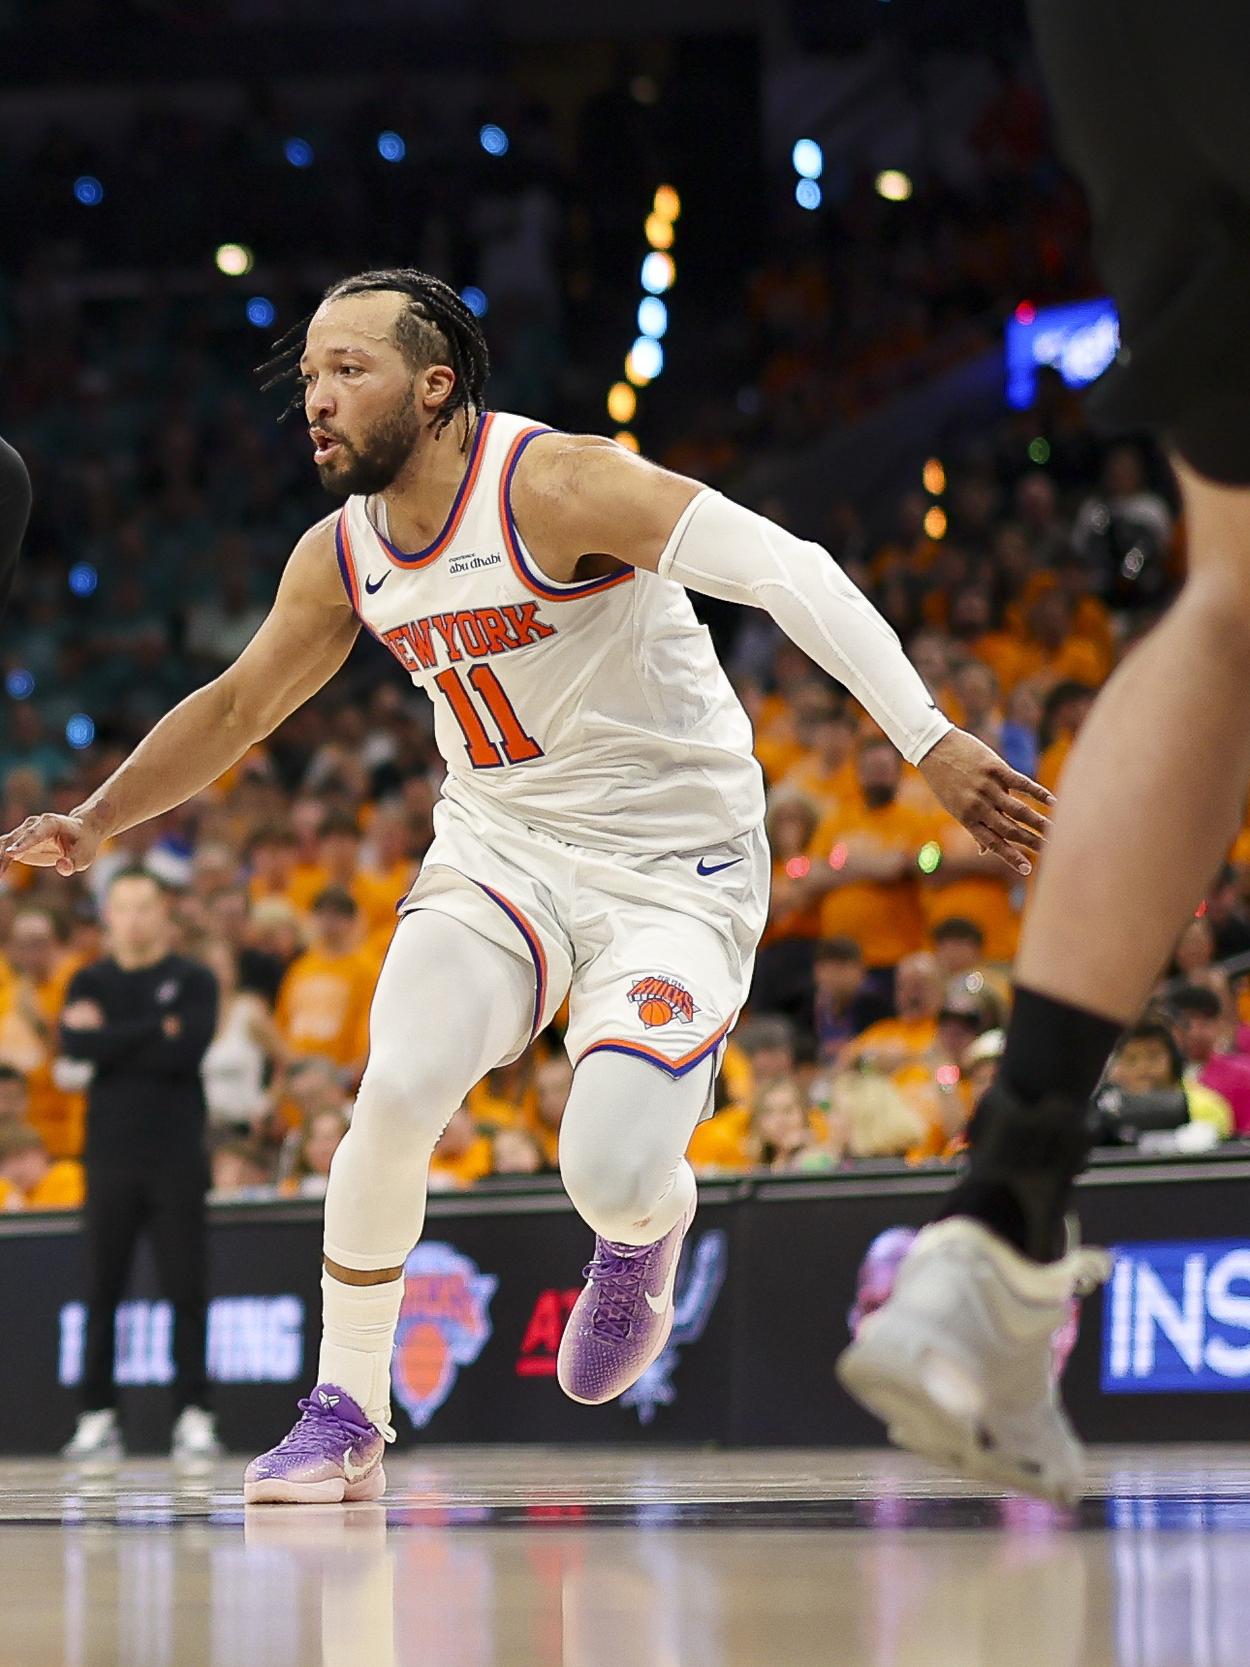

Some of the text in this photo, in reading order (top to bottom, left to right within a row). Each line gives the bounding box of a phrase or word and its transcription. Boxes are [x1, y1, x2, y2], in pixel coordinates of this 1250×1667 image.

[449, 552, 502, 574] abu dhabi
[432, 600, 558, 663] YORK
[433, 662, 545, 770] 11
